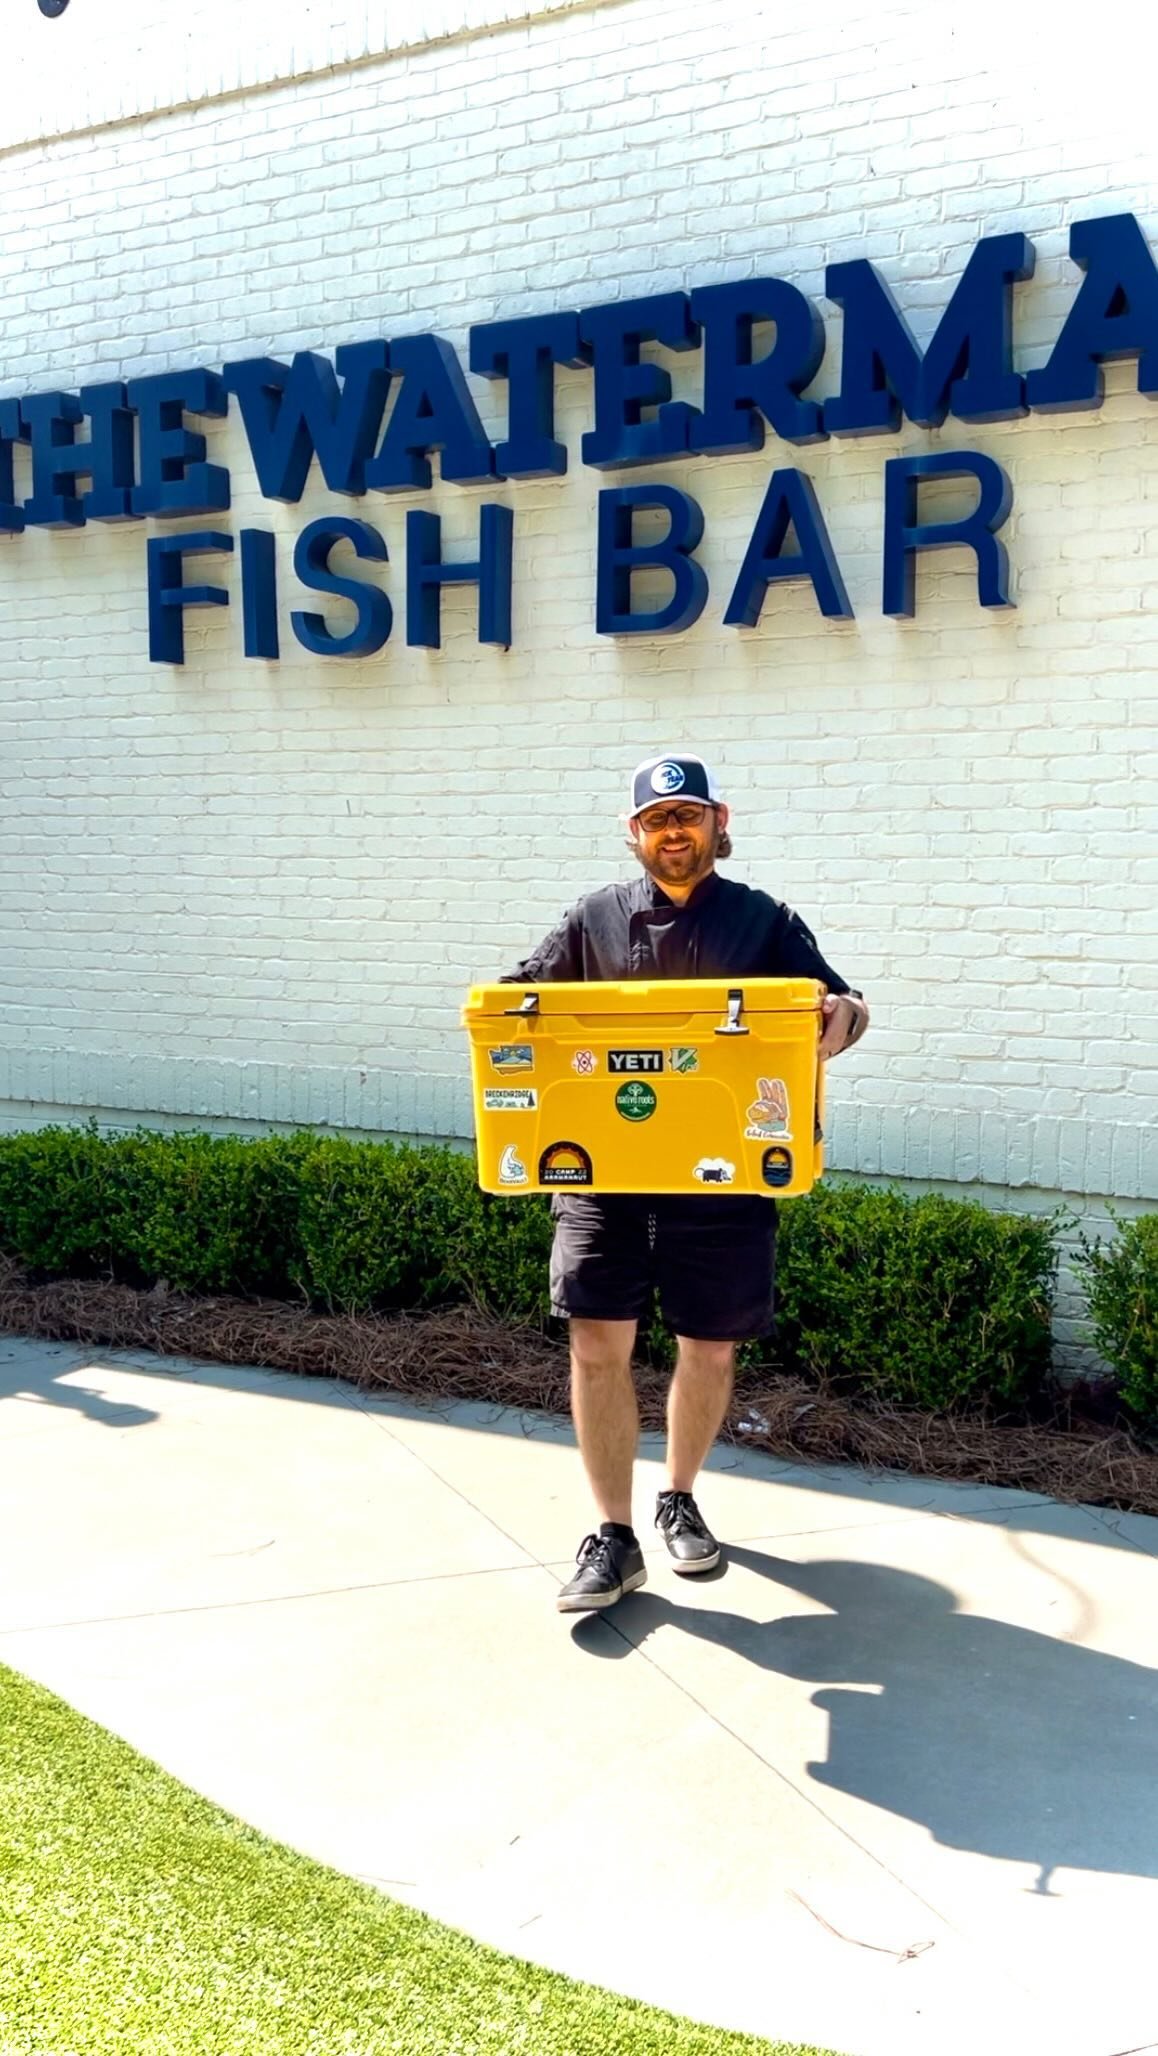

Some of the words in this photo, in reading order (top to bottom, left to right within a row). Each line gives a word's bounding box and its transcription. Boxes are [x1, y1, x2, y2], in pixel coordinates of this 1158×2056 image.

[147, 504, 513, 666] FISH
[595, 450, 1020, 637] BAR
[611, 1053, 660, 1070] YETI
